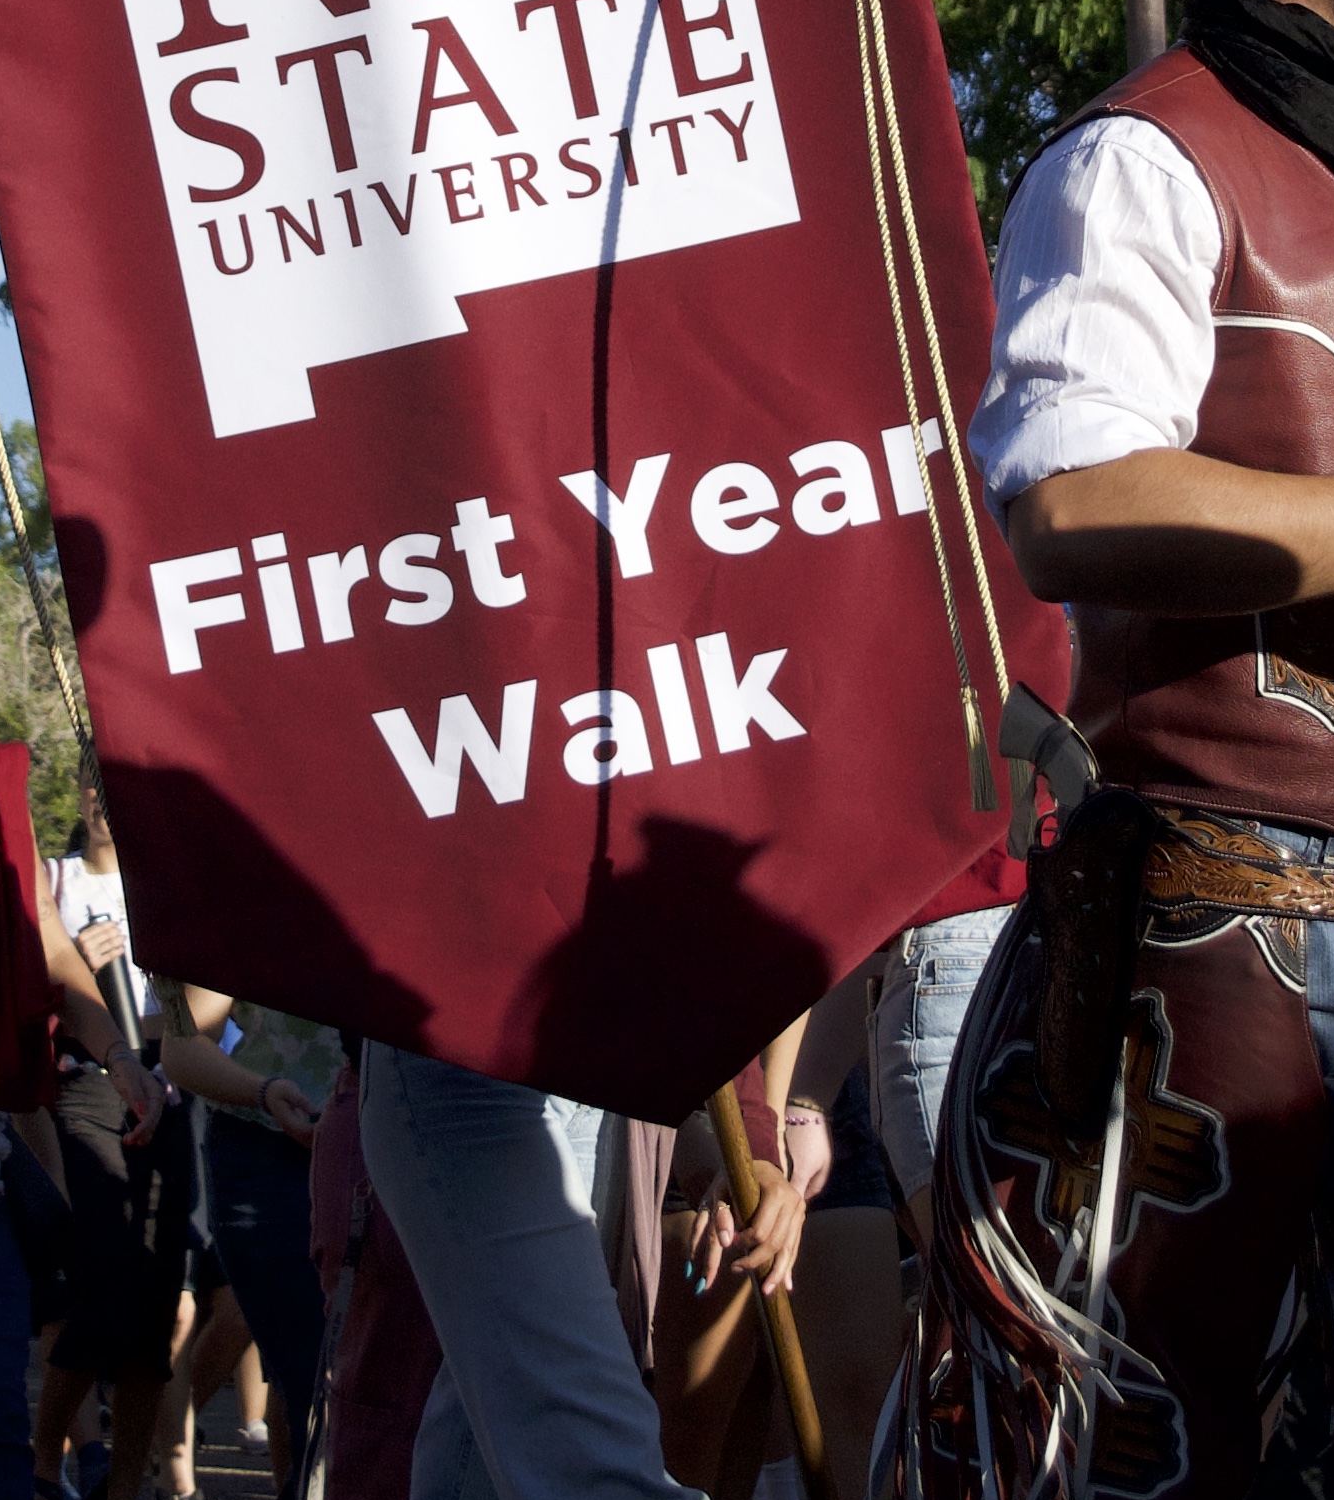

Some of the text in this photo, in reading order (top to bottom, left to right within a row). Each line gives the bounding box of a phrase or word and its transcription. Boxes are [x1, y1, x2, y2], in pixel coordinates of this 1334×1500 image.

[197, 100, 755, 276] UNIVERSITY
[149, 417, 944, 675] First Year
[371, 631, 809, 819] Walk
